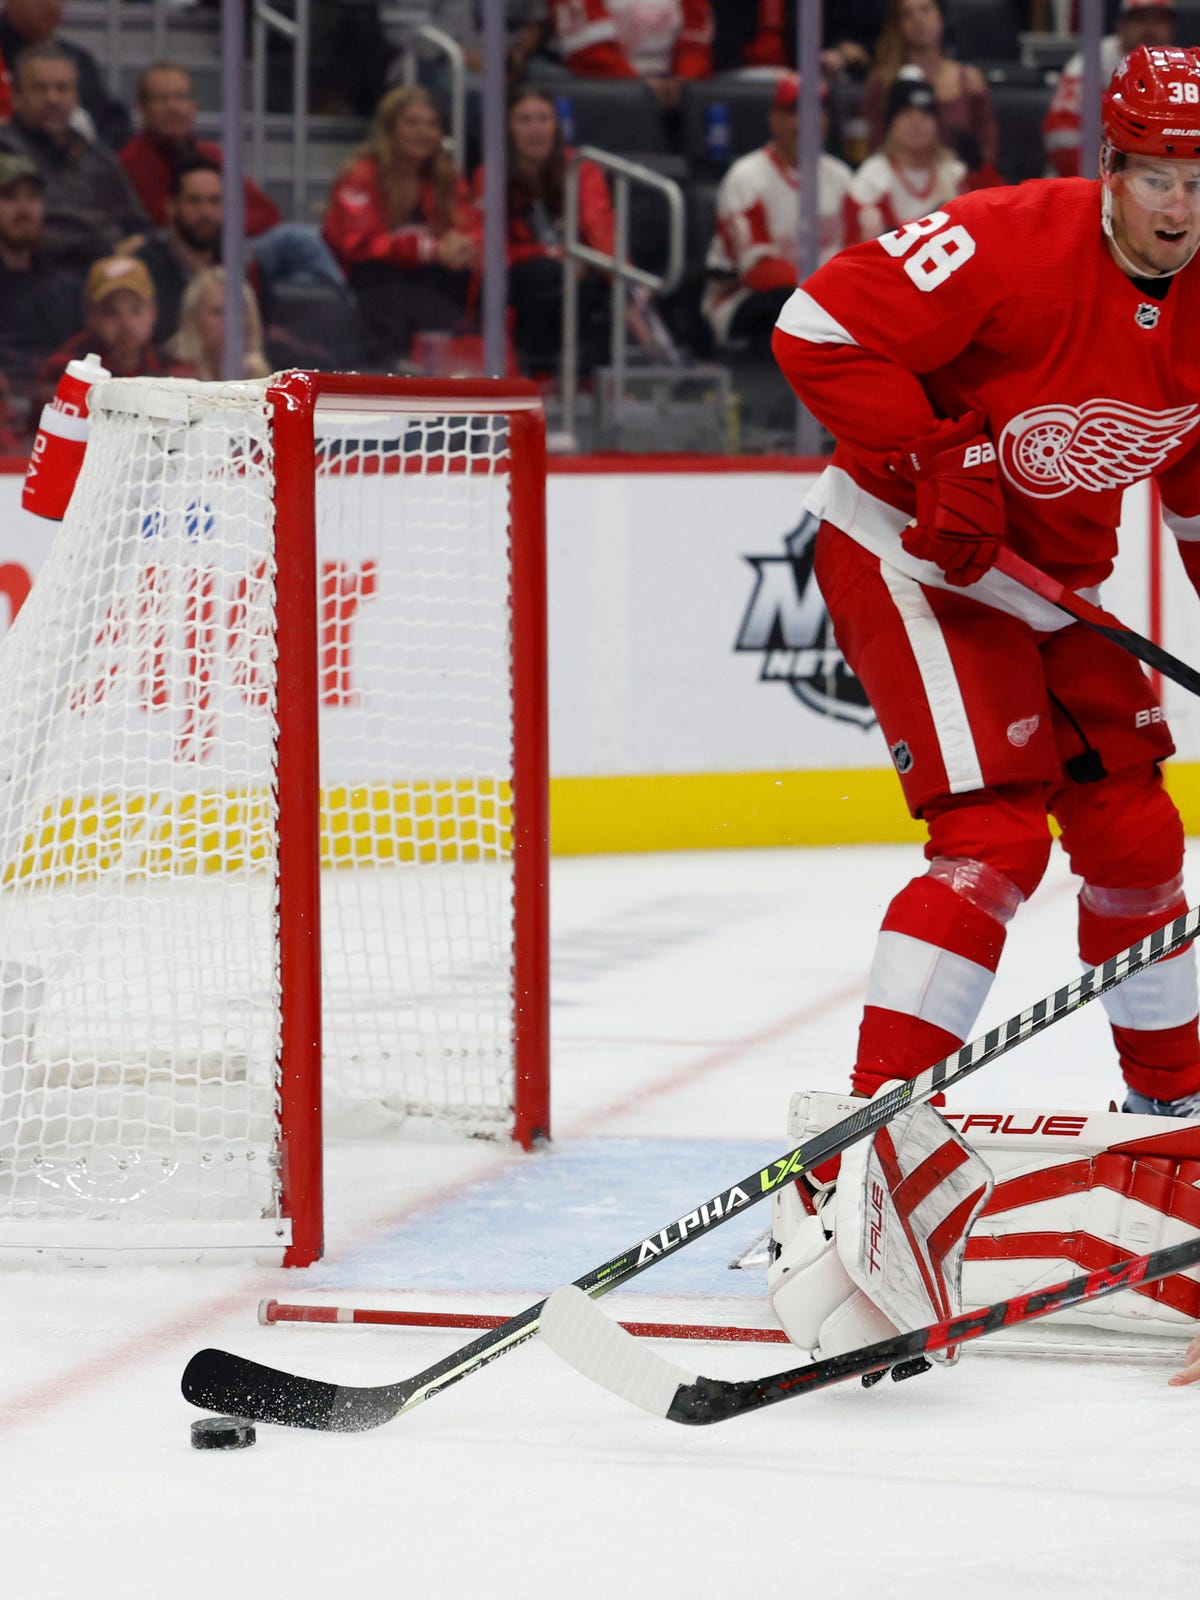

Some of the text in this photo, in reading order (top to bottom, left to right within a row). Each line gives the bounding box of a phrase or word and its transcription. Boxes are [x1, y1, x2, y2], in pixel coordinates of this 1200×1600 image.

[1167, 82, 1200, 104] 38
[877, 210, 976, 292] 38
[636, 1149, 804, 1268] ALPHA LX
[870, 1181, 884, 1275] TRUE
